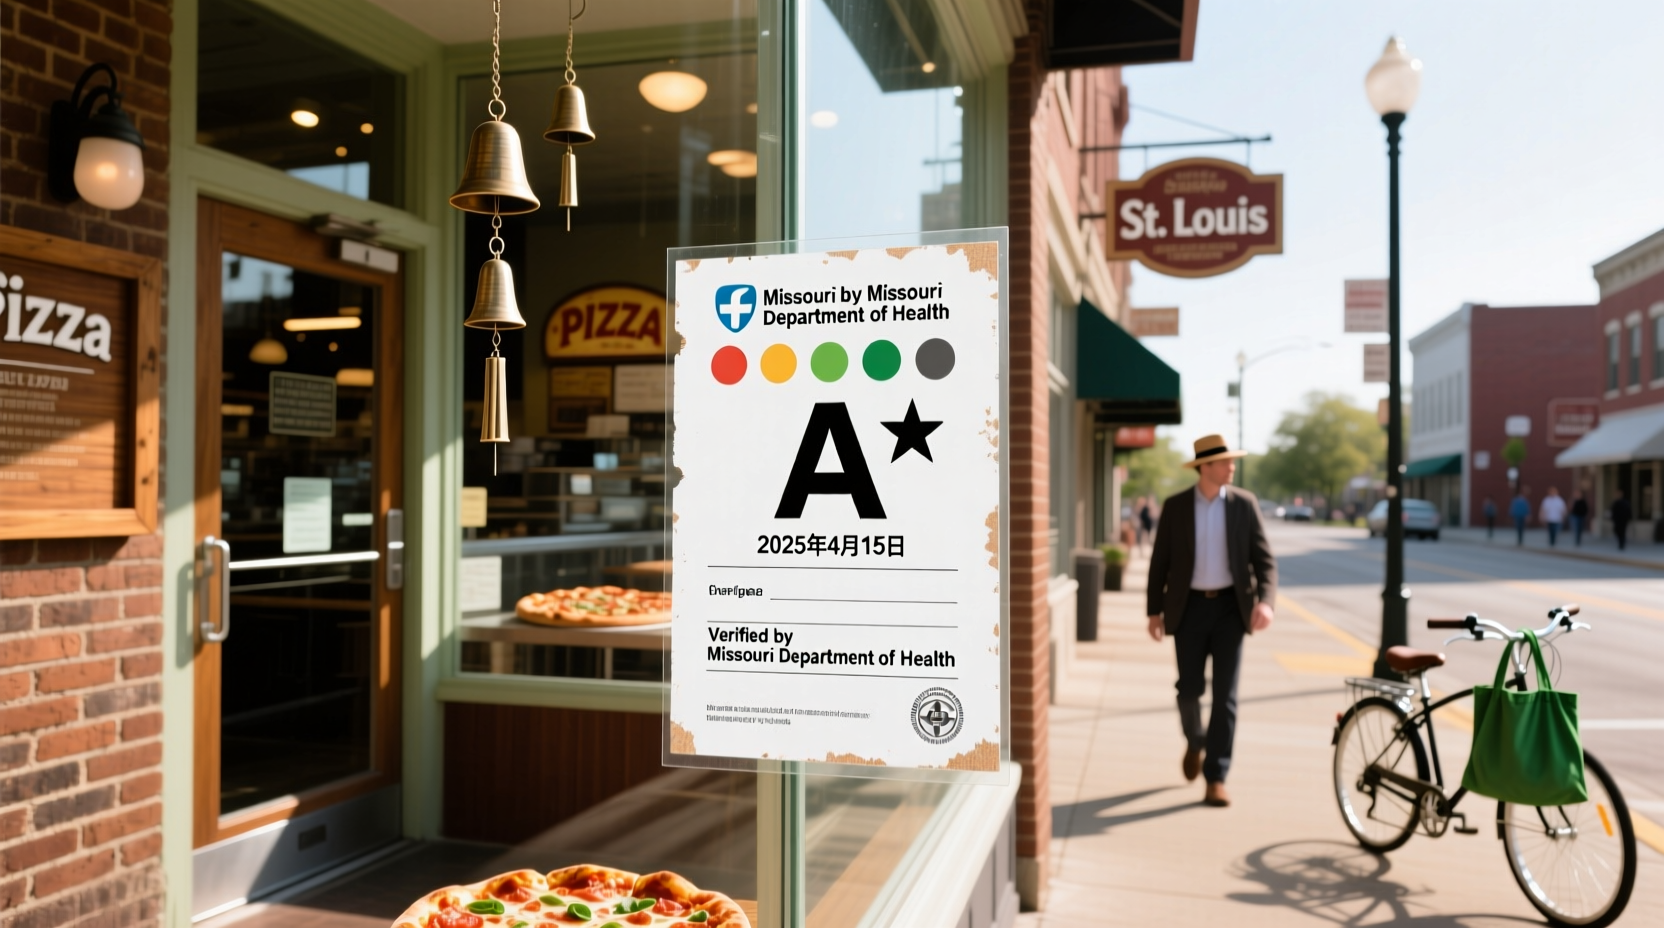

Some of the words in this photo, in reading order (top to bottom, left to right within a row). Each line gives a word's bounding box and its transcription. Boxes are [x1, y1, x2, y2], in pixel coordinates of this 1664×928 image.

[1120, 198, 1168, 240] St.
[1173, 195, 1269, 238] Louis
[763, 286, 837, 306] Missouri
[840, 285, 863, 306] by
[867, 282, 943, 302] Missouri
[0, 270, 112, 363] izza
[559, 302, 662, 349] PIZZA
[763, 308, 865, 330] Department
[869, 304, 888, 323] of
[892, 303, 950, 321] Health
[773, 401, 888, 520] A
[757, 532, 905, 558] 2025年4月15日
[707, 626, 769, 643] Verified
[773, 627, 794, 647] by
[707, 645, 775, 663] Missouri
[779, 647, 875, 669] Department
[878, 649, 896, 667] of
[900, 650, 956, 668] Health
